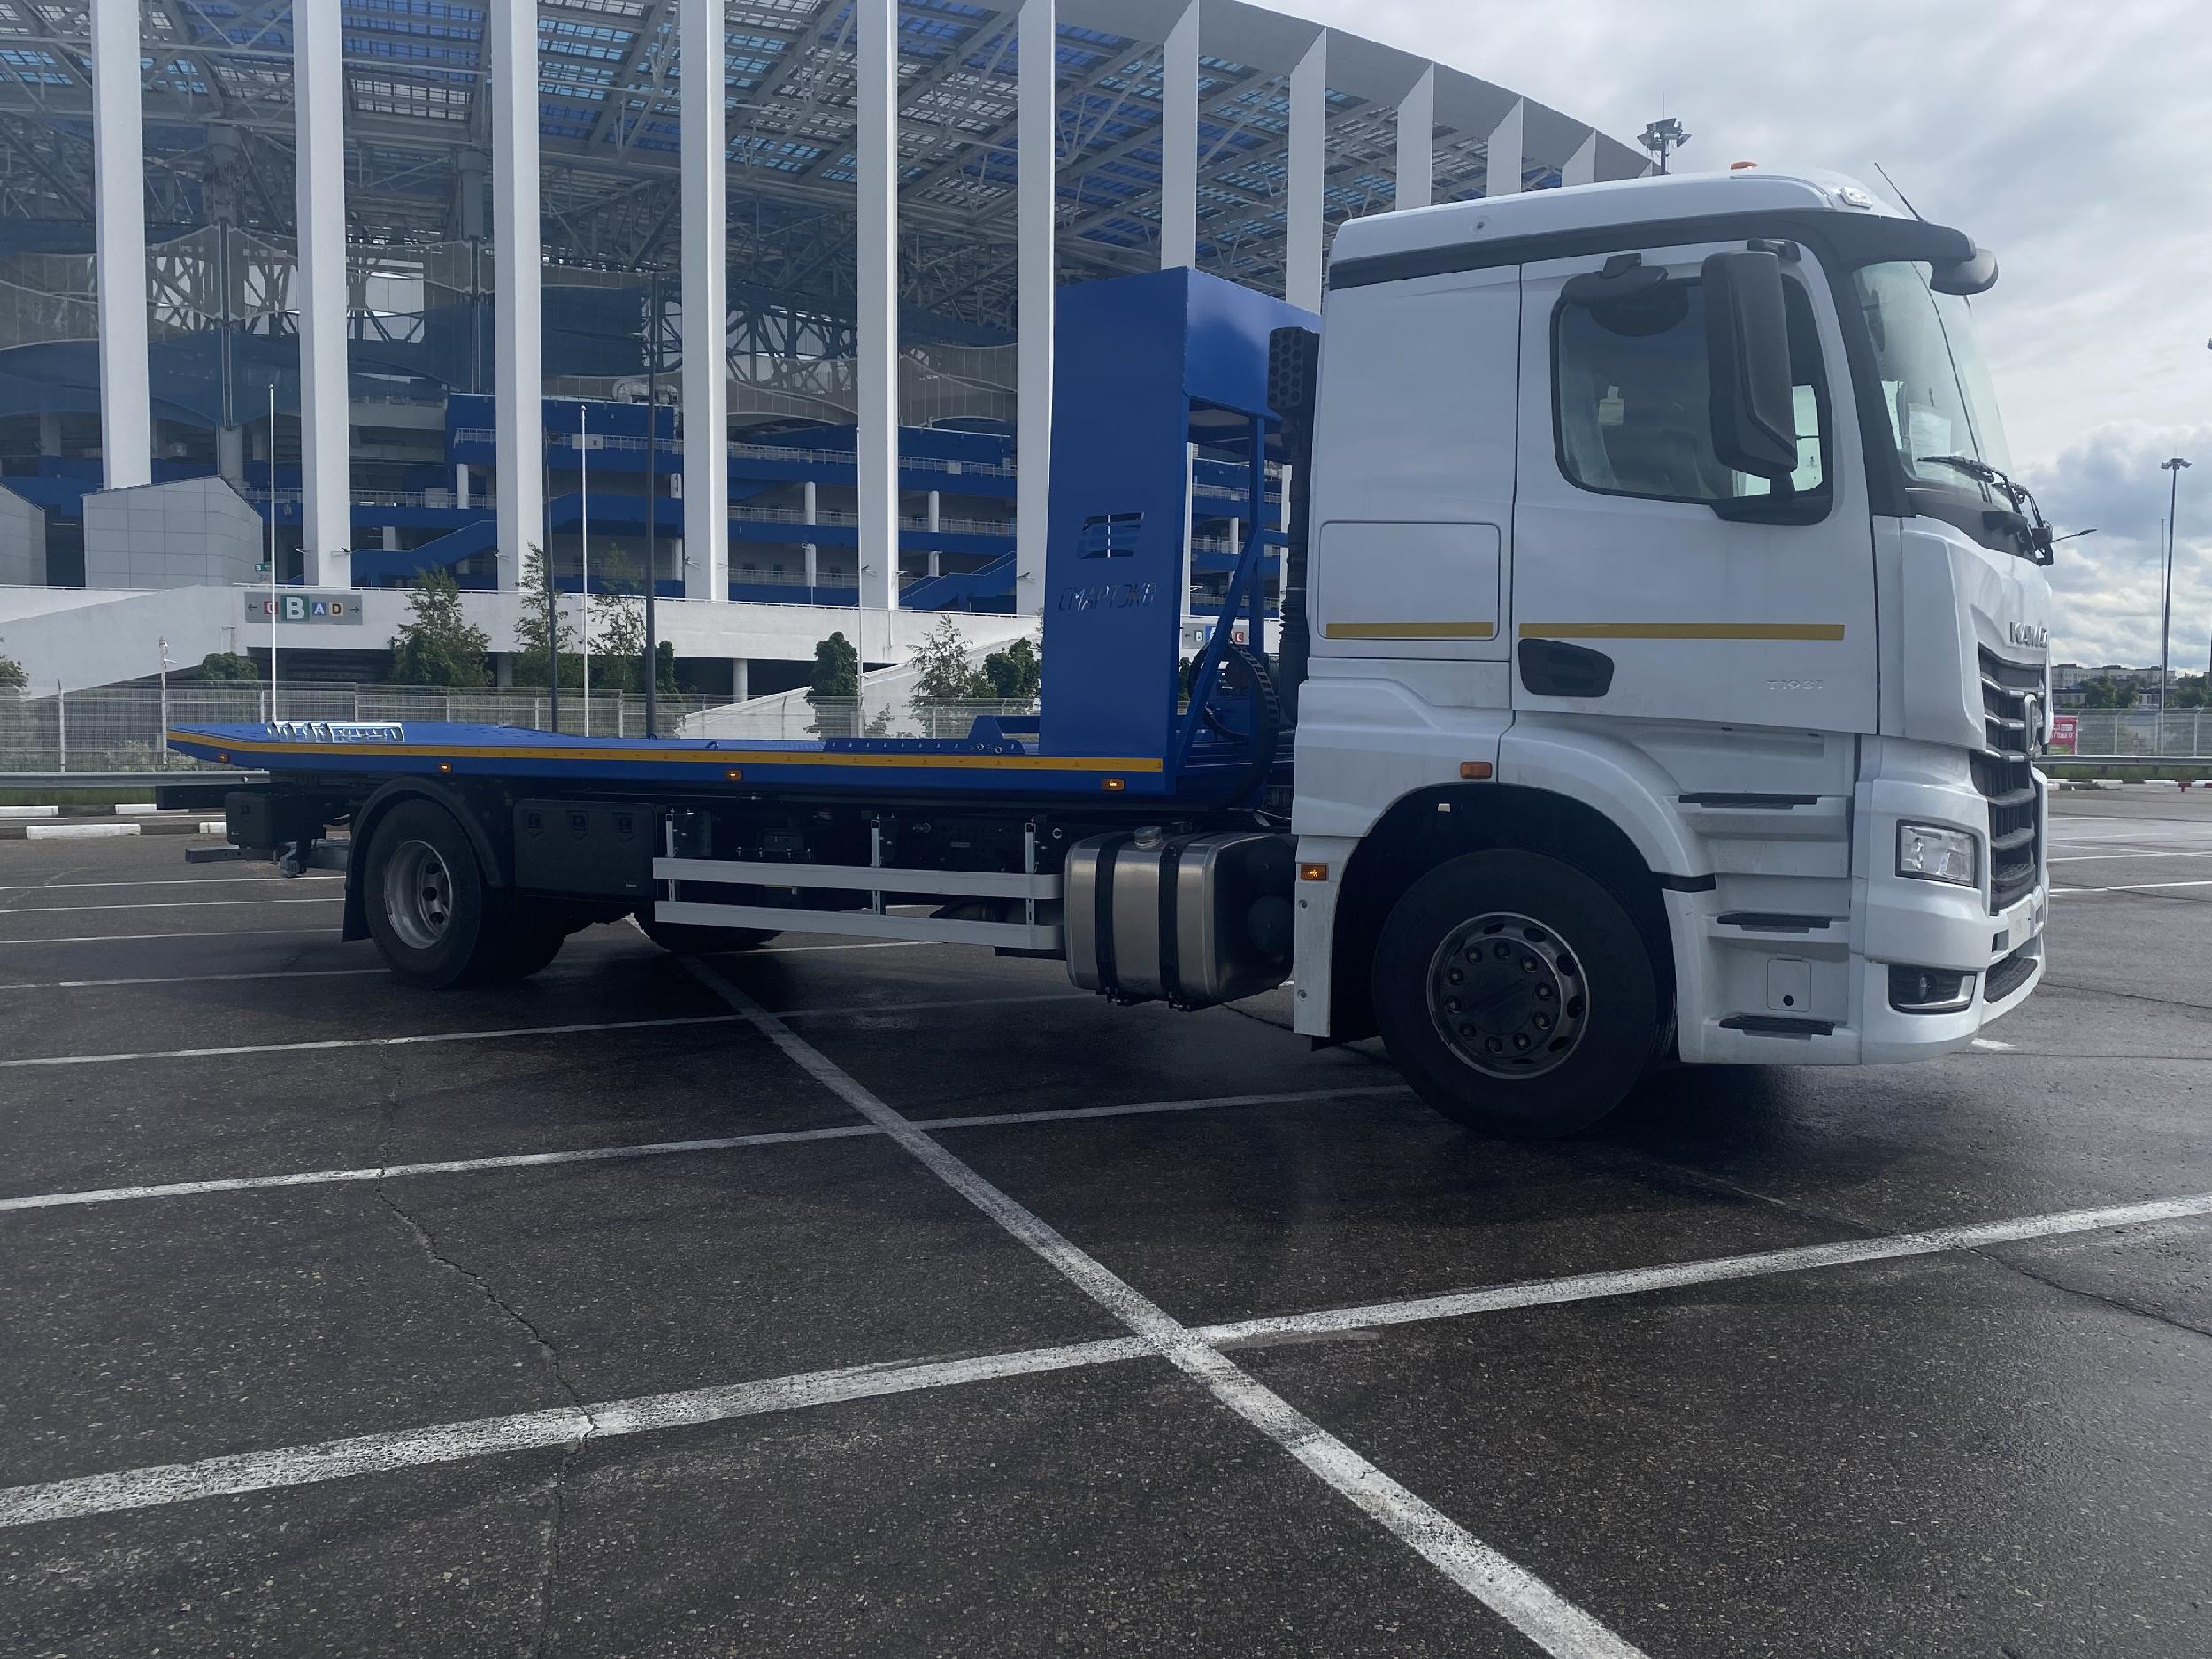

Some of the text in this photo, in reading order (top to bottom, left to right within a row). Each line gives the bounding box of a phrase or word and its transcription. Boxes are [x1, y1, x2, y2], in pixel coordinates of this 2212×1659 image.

[286, 597, 305, 619] B
[314, 603, 325, 615] A
[332, 603, 342, 615] D
[1195, 631, 1203, 641] B
[1236, 633, 1243, 642] C
